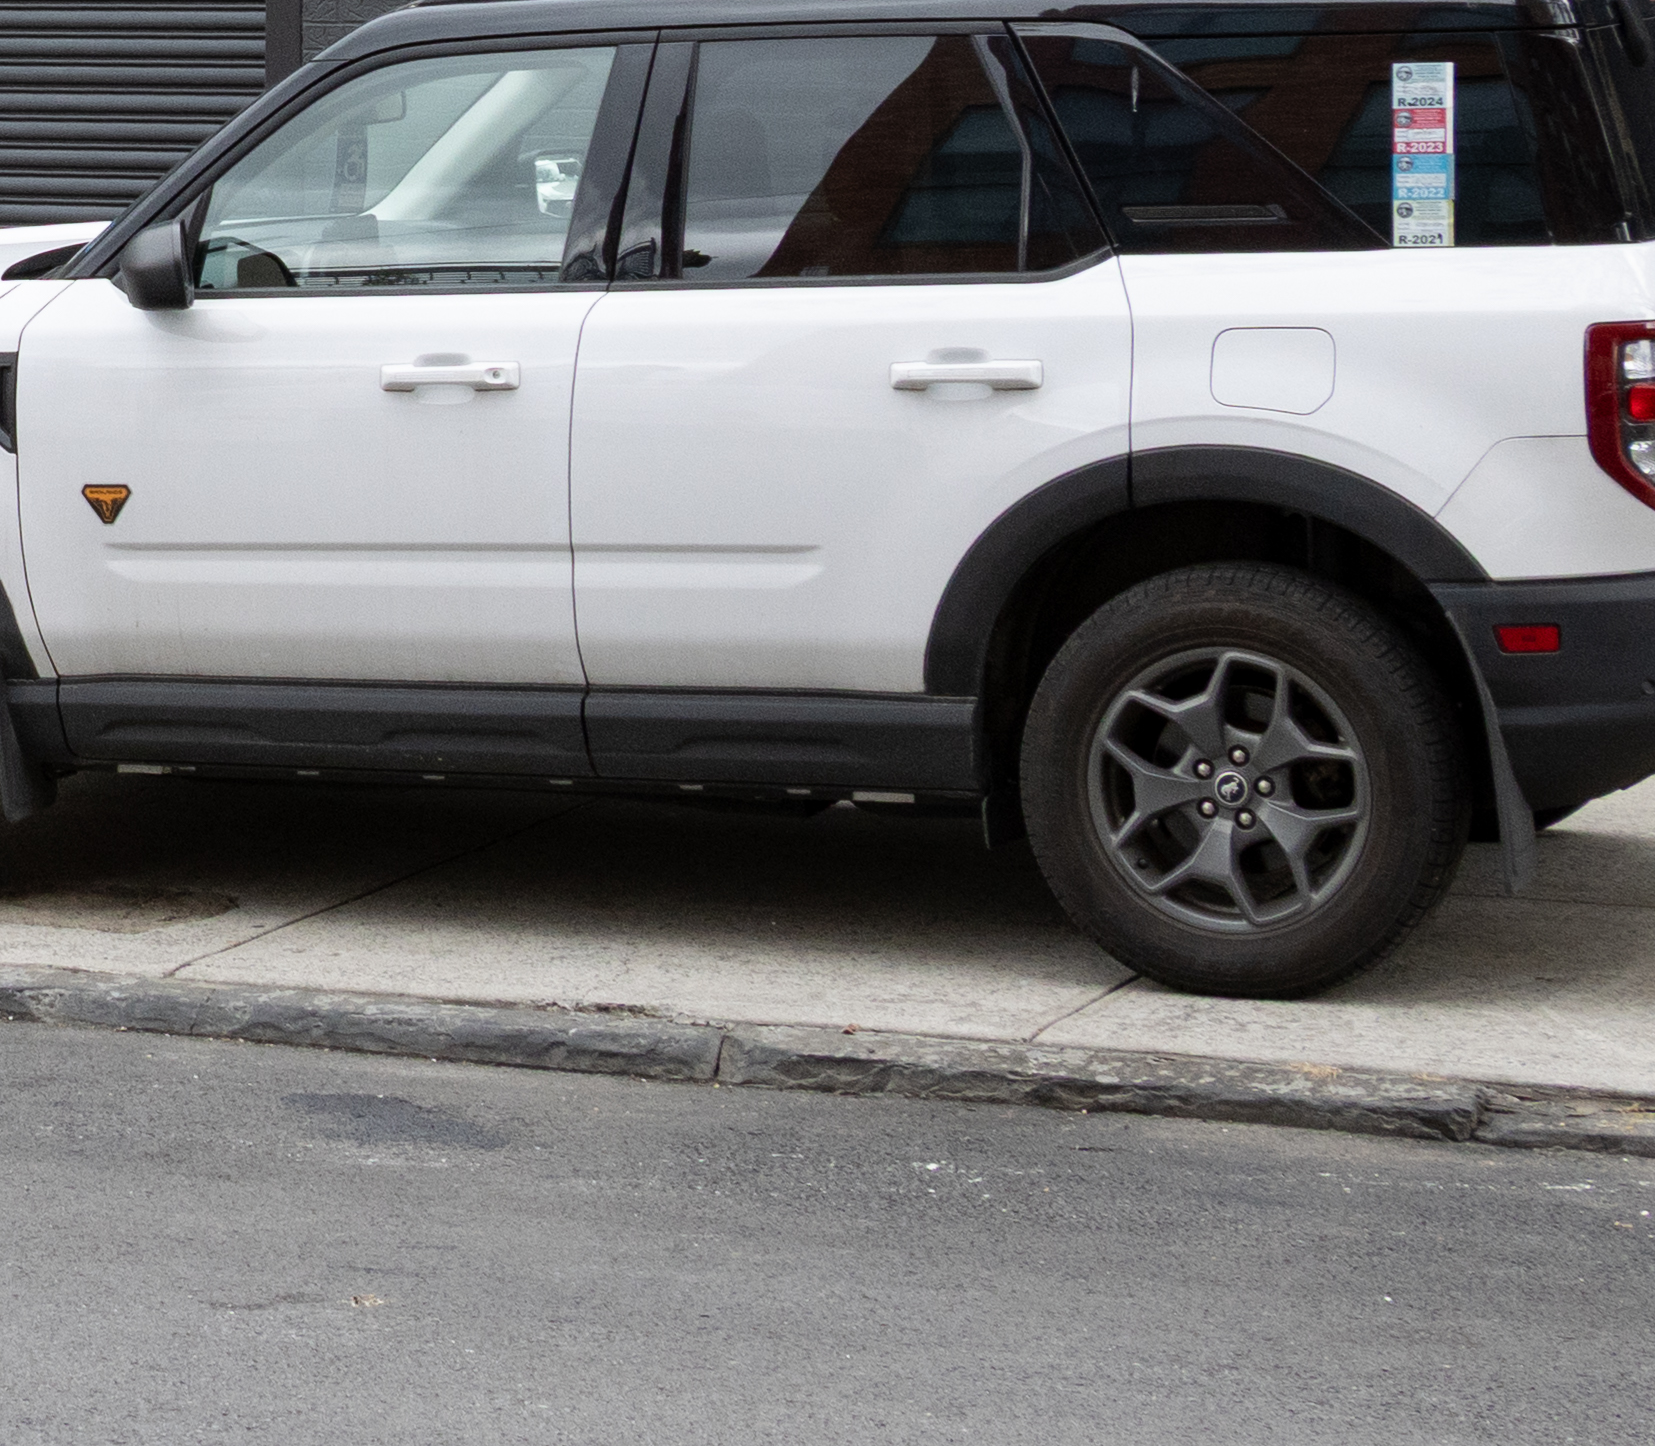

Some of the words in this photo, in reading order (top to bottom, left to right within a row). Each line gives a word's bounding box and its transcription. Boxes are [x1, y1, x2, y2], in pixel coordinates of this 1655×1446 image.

[1397, 97, 1444, 107] R-2024
[1396, 142, 1444, 153] R-2023
[1397, 188, 1445, 198] R-2022
